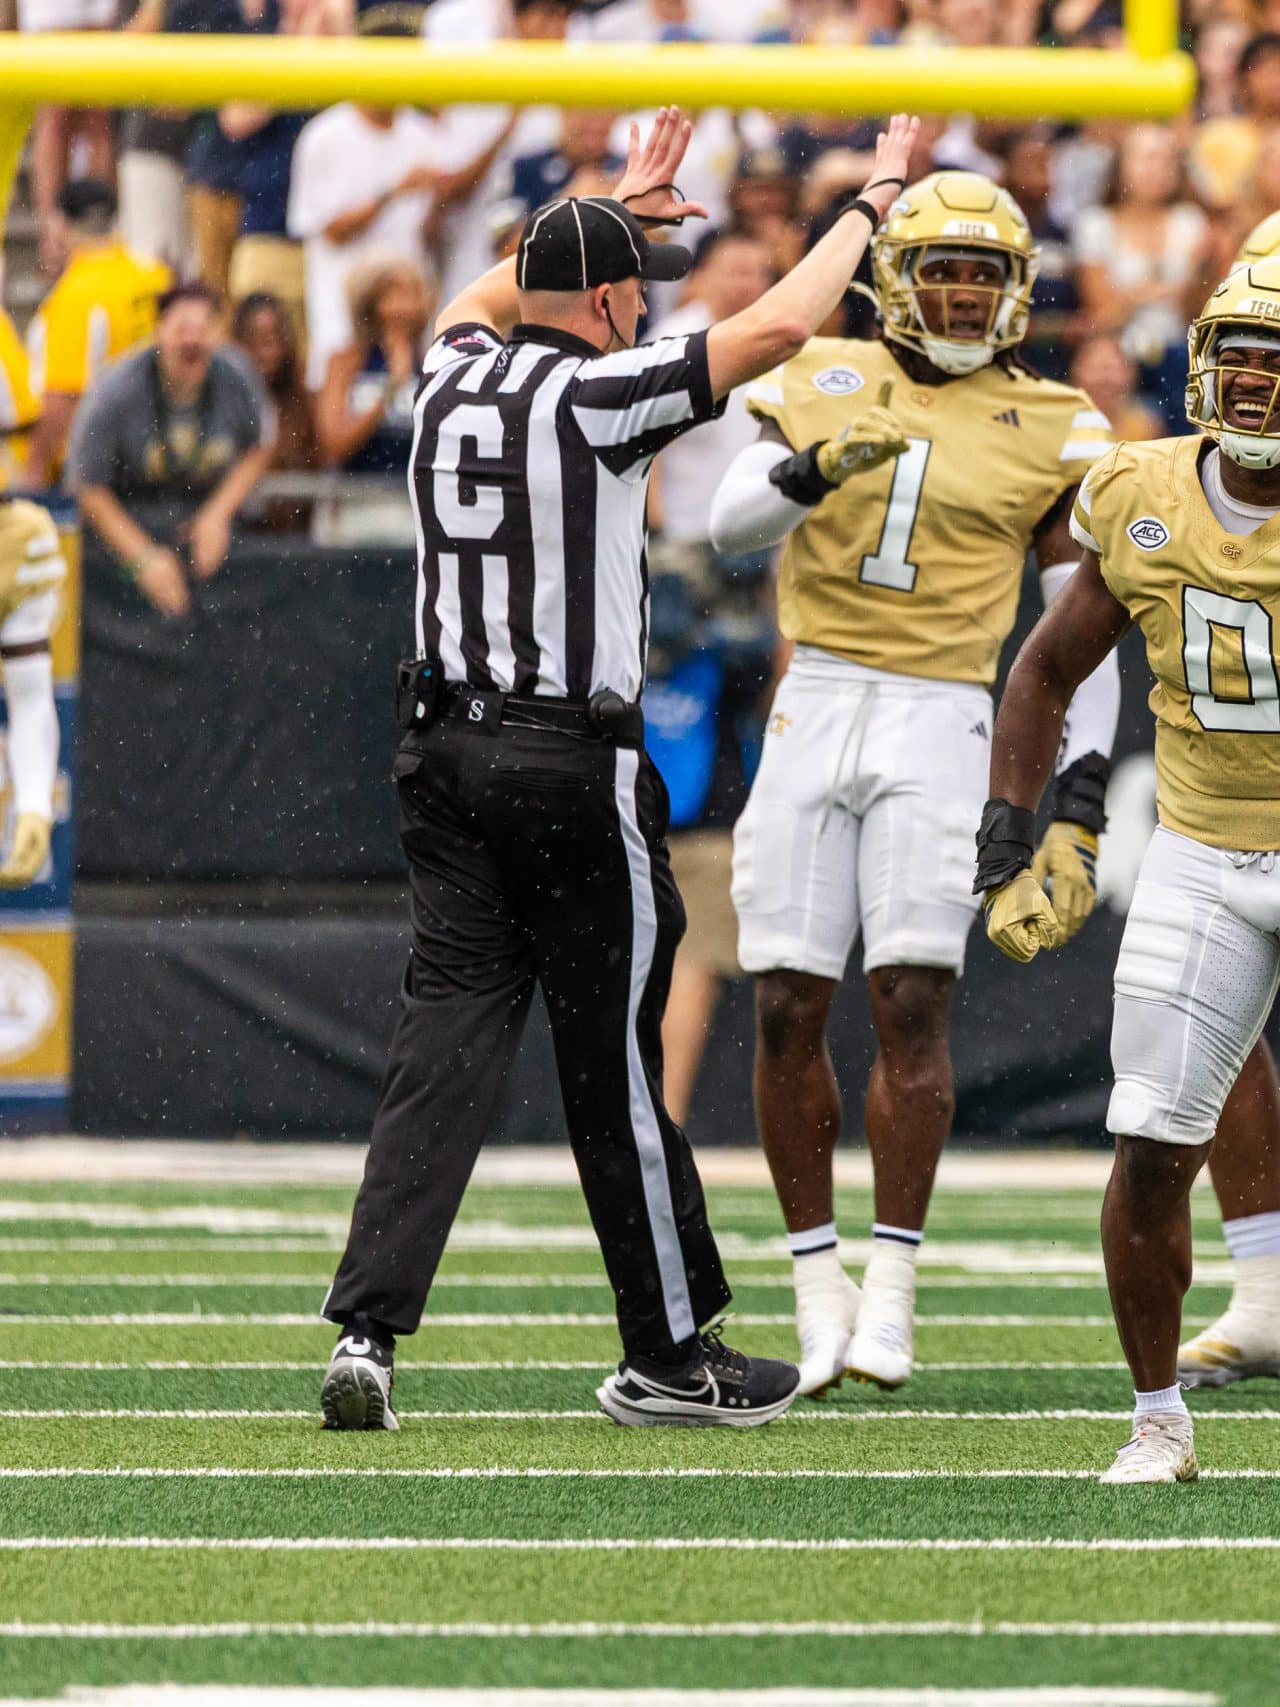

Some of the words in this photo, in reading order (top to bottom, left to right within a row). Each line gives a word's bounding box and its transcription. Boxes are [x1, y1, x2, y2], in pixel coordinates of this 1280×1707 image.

[432, 403, 504, 540] C
[859, 437, 932, 594] 1
[1135, 526, 1164, 539] ACC
[1222, 544, 1241, 559] GT
